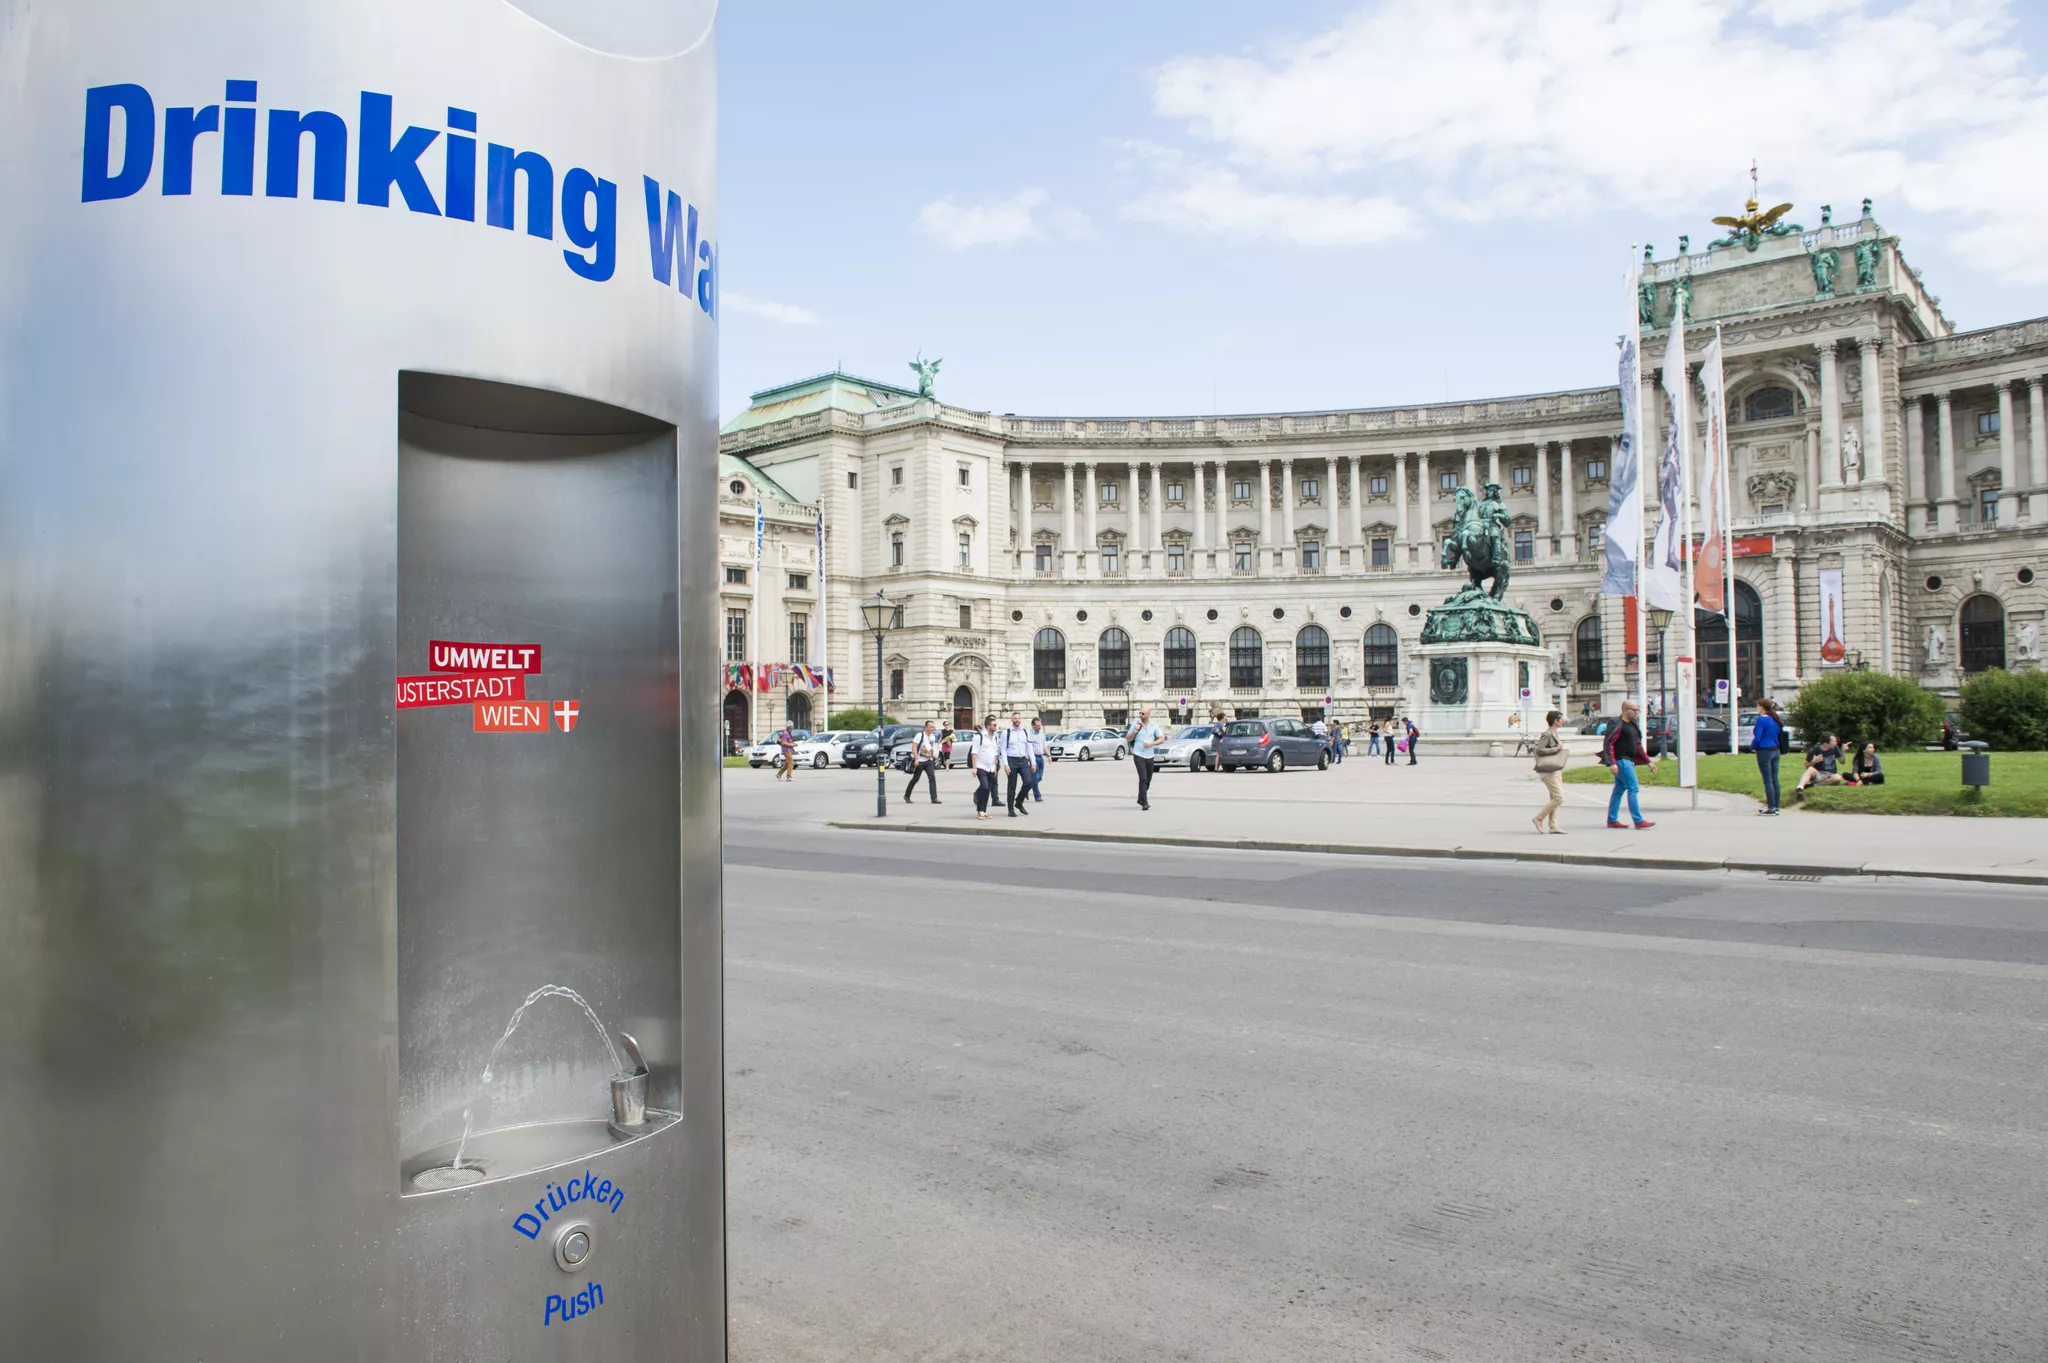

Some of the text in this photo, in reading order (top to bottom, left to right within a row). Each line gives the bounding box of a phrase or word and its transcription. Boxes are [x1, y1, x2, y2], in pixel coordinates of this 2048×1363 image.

[80, 79, 617, 283] Drinking
[434, 646, 535, 669] UMWELT
[396, 676, 516, 703] USTERSTADT
[481, 705, 540, 726] WIEN
[512, 1170, 625, 1240] Drücken
[543, 1281, 604, 1326] Push
